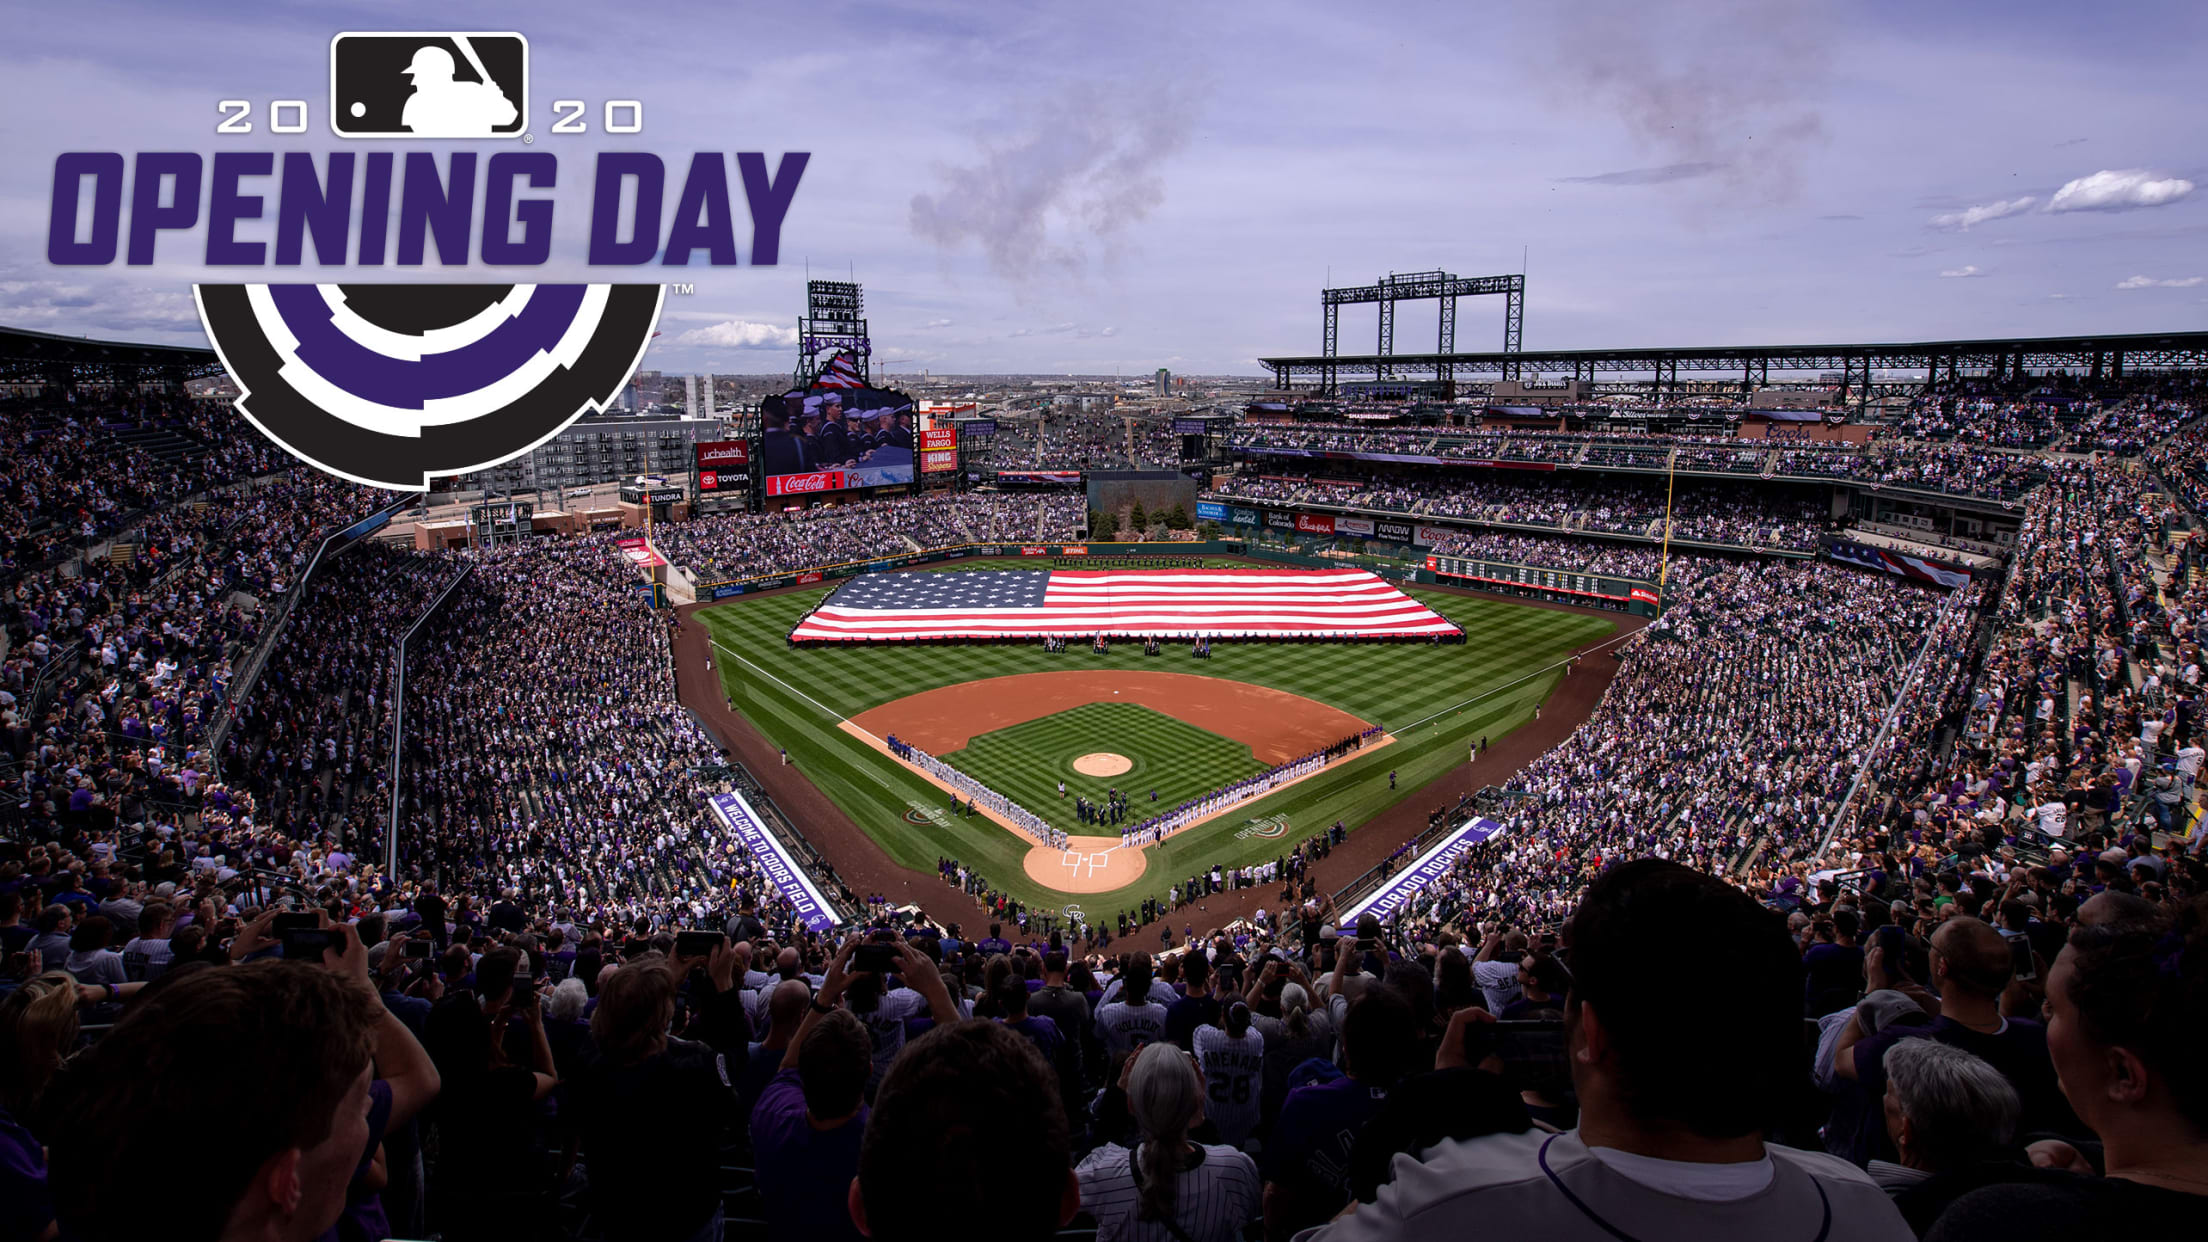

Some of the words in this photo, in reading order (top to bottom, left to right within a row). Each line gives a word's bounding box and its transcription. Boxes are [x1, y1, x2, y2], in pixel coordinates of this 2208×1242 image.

[926, 431, 951, 439] WELLS
[927, 440, 951, 448] FARGO
[703, 447, 742, 460] uchealth
[928, 452, 951, 463] KING
[717, 474, 749, 483] TOYOTA
[650, 494, 681, 502] TUNDRA
[1233, 514, 1256, 525] dental
[1268, 512, 1283, 521] Bank
[1268, 519, 1295, 529] Colorado
[1378, 524, 1410, 535] ARROW
[1420, 527, 1454, 541] Coor
[724, 803, 759, 842] WELCOME
[752, 840, 768, 854] TO
[760, 850, 793, 884] COORS
[783, 882, 816, 914] FIELD
[1421, 838, 1474, 877] ROCKIES
[1210, 1072, 1250, 1104] 28
